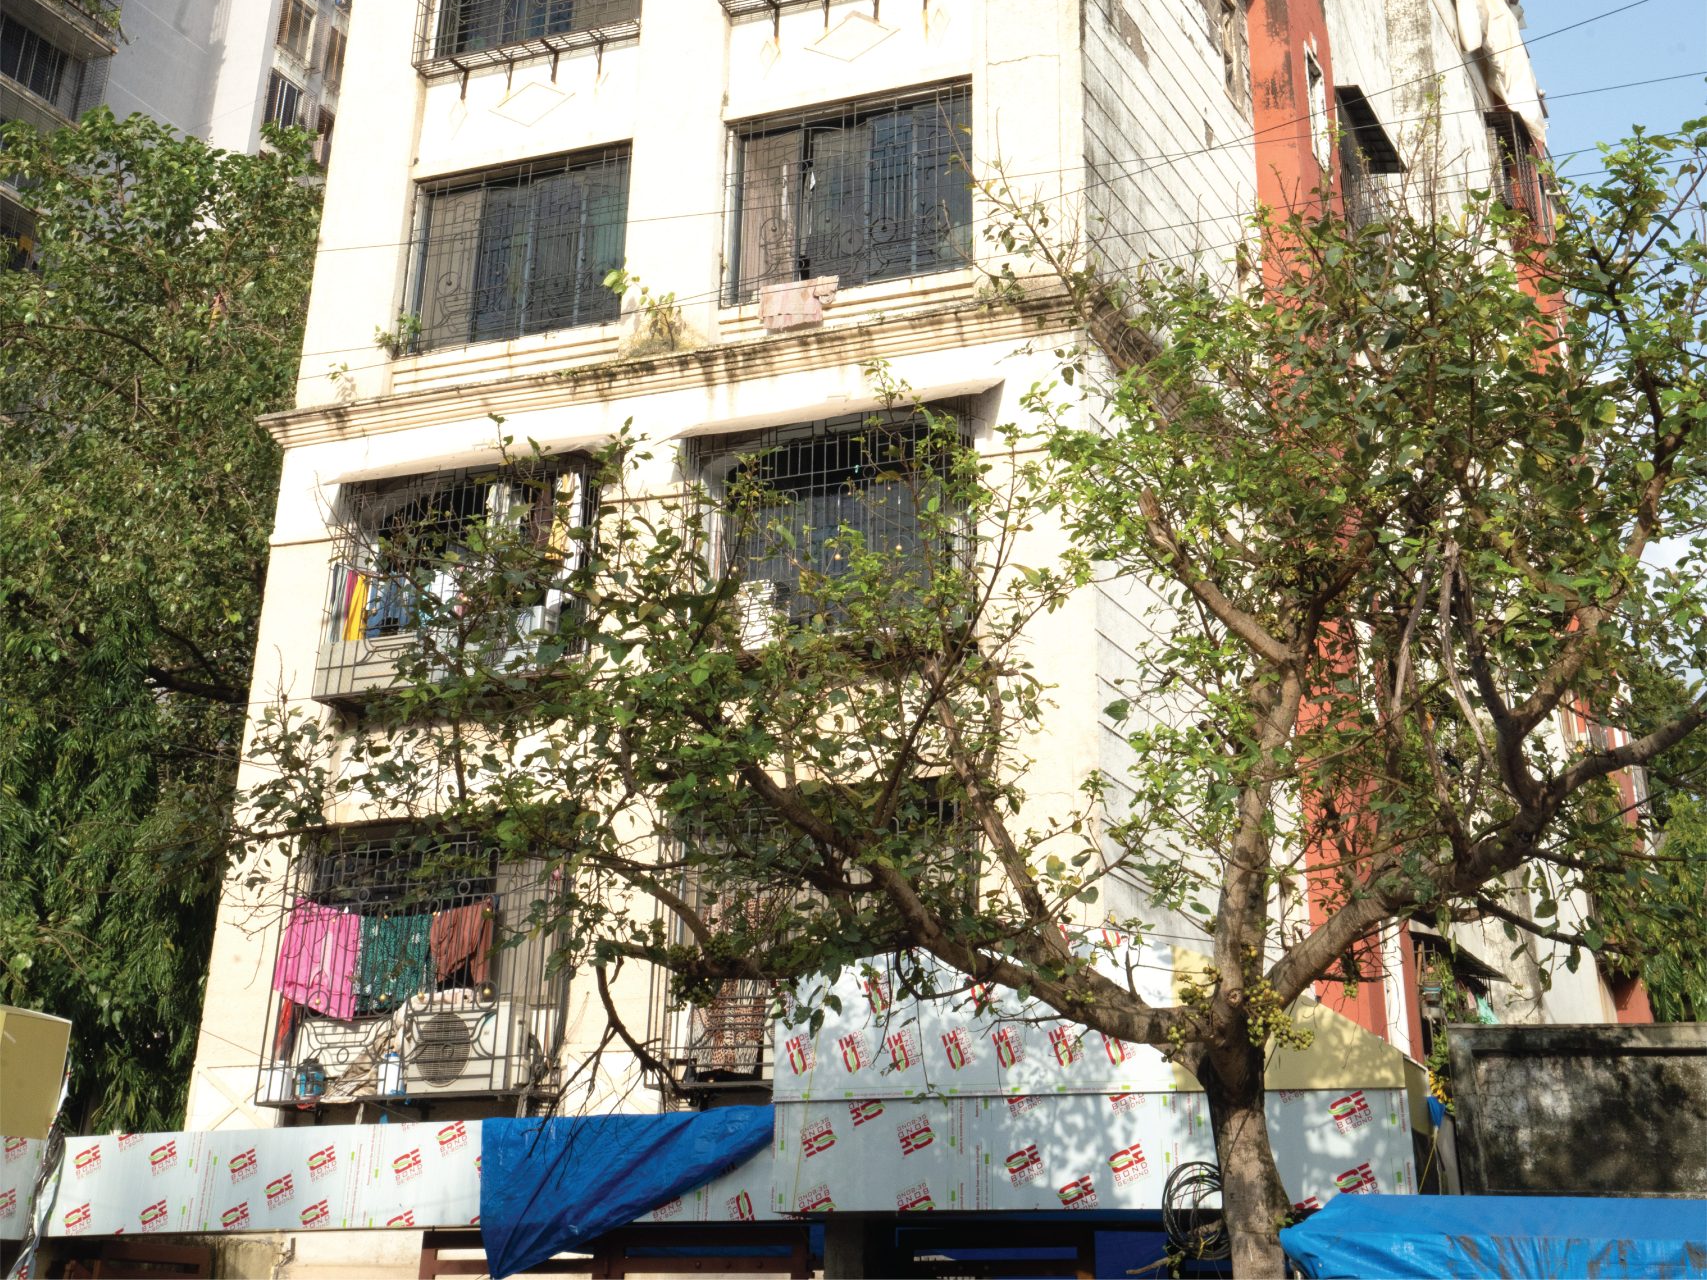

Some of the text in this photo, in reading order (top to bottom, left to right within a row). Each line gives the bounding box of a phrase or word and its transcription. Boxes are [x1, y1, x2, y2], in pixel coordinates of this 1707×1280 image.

[898, 1119, 929, 1139] BOND
[1336, 1108, 1371, 1130] BOND
[801, 1121, 832, 1142] BOND
[310, 1160, 337, 1178] BOND
[1011, 1162, 1043, 1182] BOND
[1114, 1161, 1148, 1182] BOND
[267, 1188, 294, 1206] BOND
[799, 1189, 830, 1209] BOND
[897, 1187, 929, 1207] BOND
[653, 1199, 682, 1218] BOND
